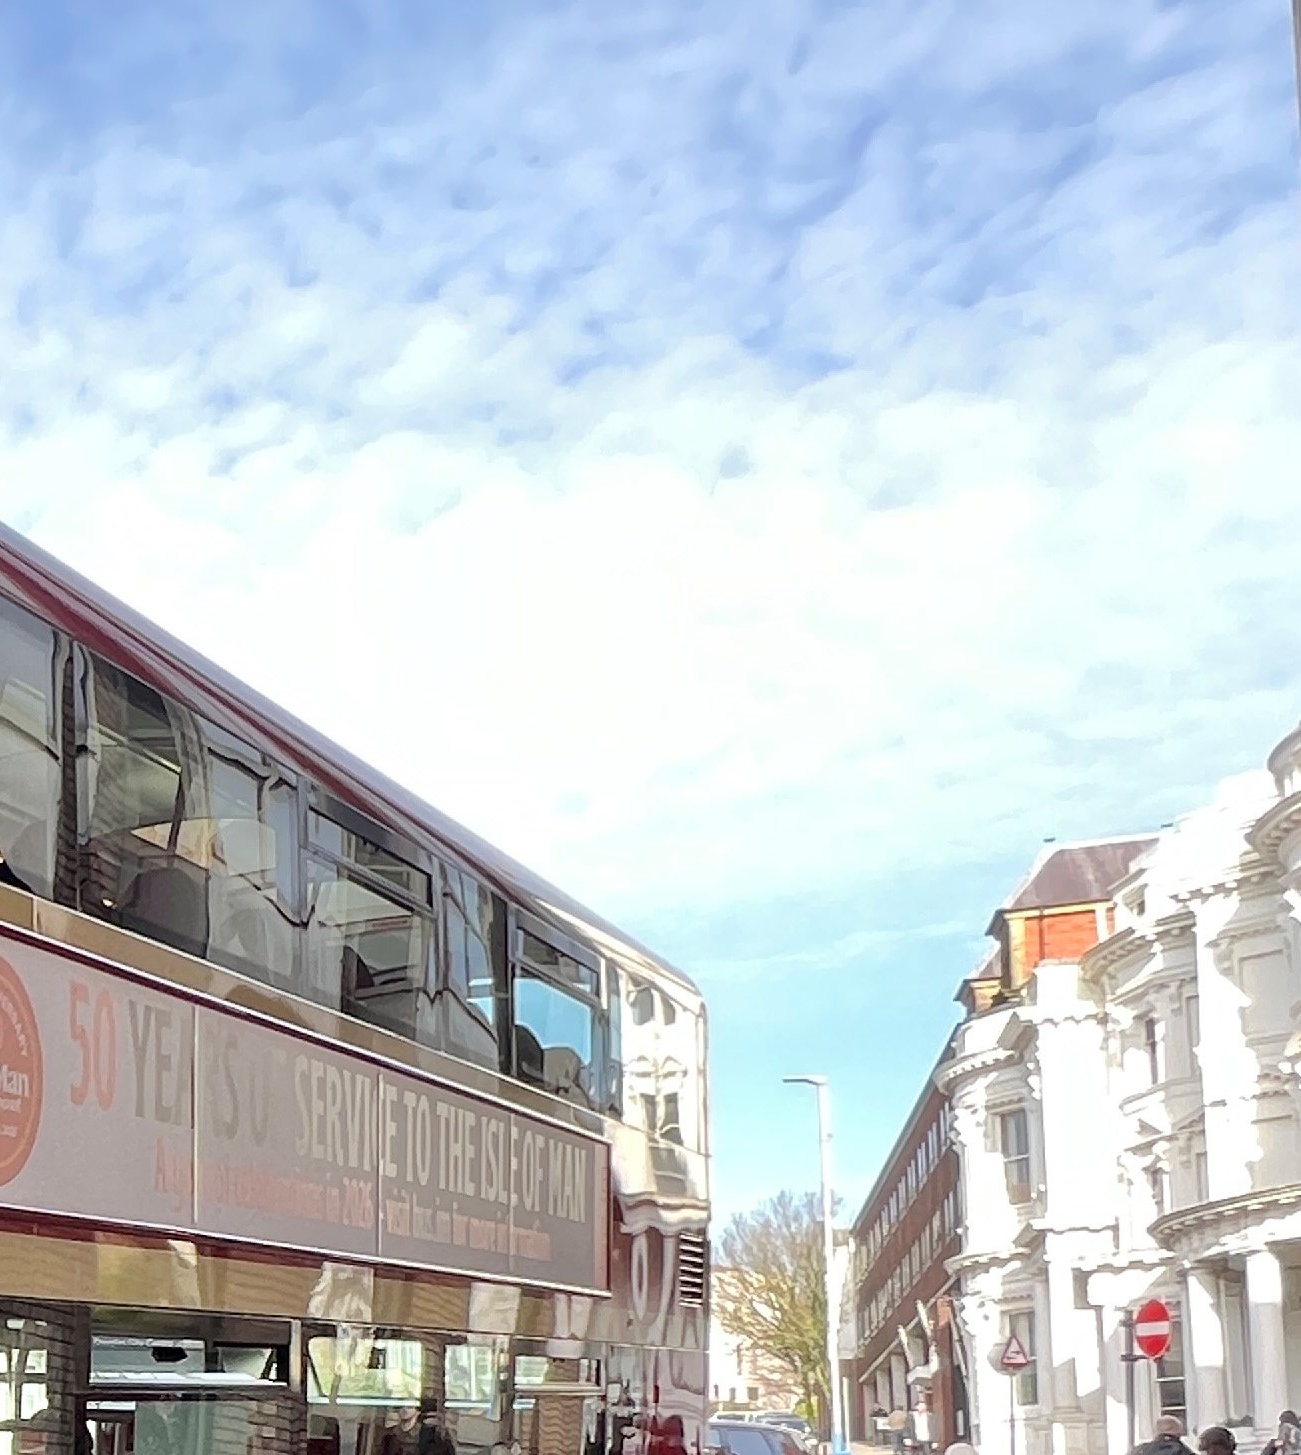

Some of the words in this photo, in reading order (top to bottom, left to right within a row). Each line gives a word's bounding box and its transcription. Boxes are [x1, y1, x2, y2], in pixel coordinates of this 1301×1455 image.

[69, 979, 117, 1111] 50
[402, 1090, 432, 1187] TO
[436, 1101, 477, 1197] THE
[480, 1116, 519, 1207] ISLE
[522, 1129, 546, 1213] OF
[548, 1138, 588, 1223] MAN
